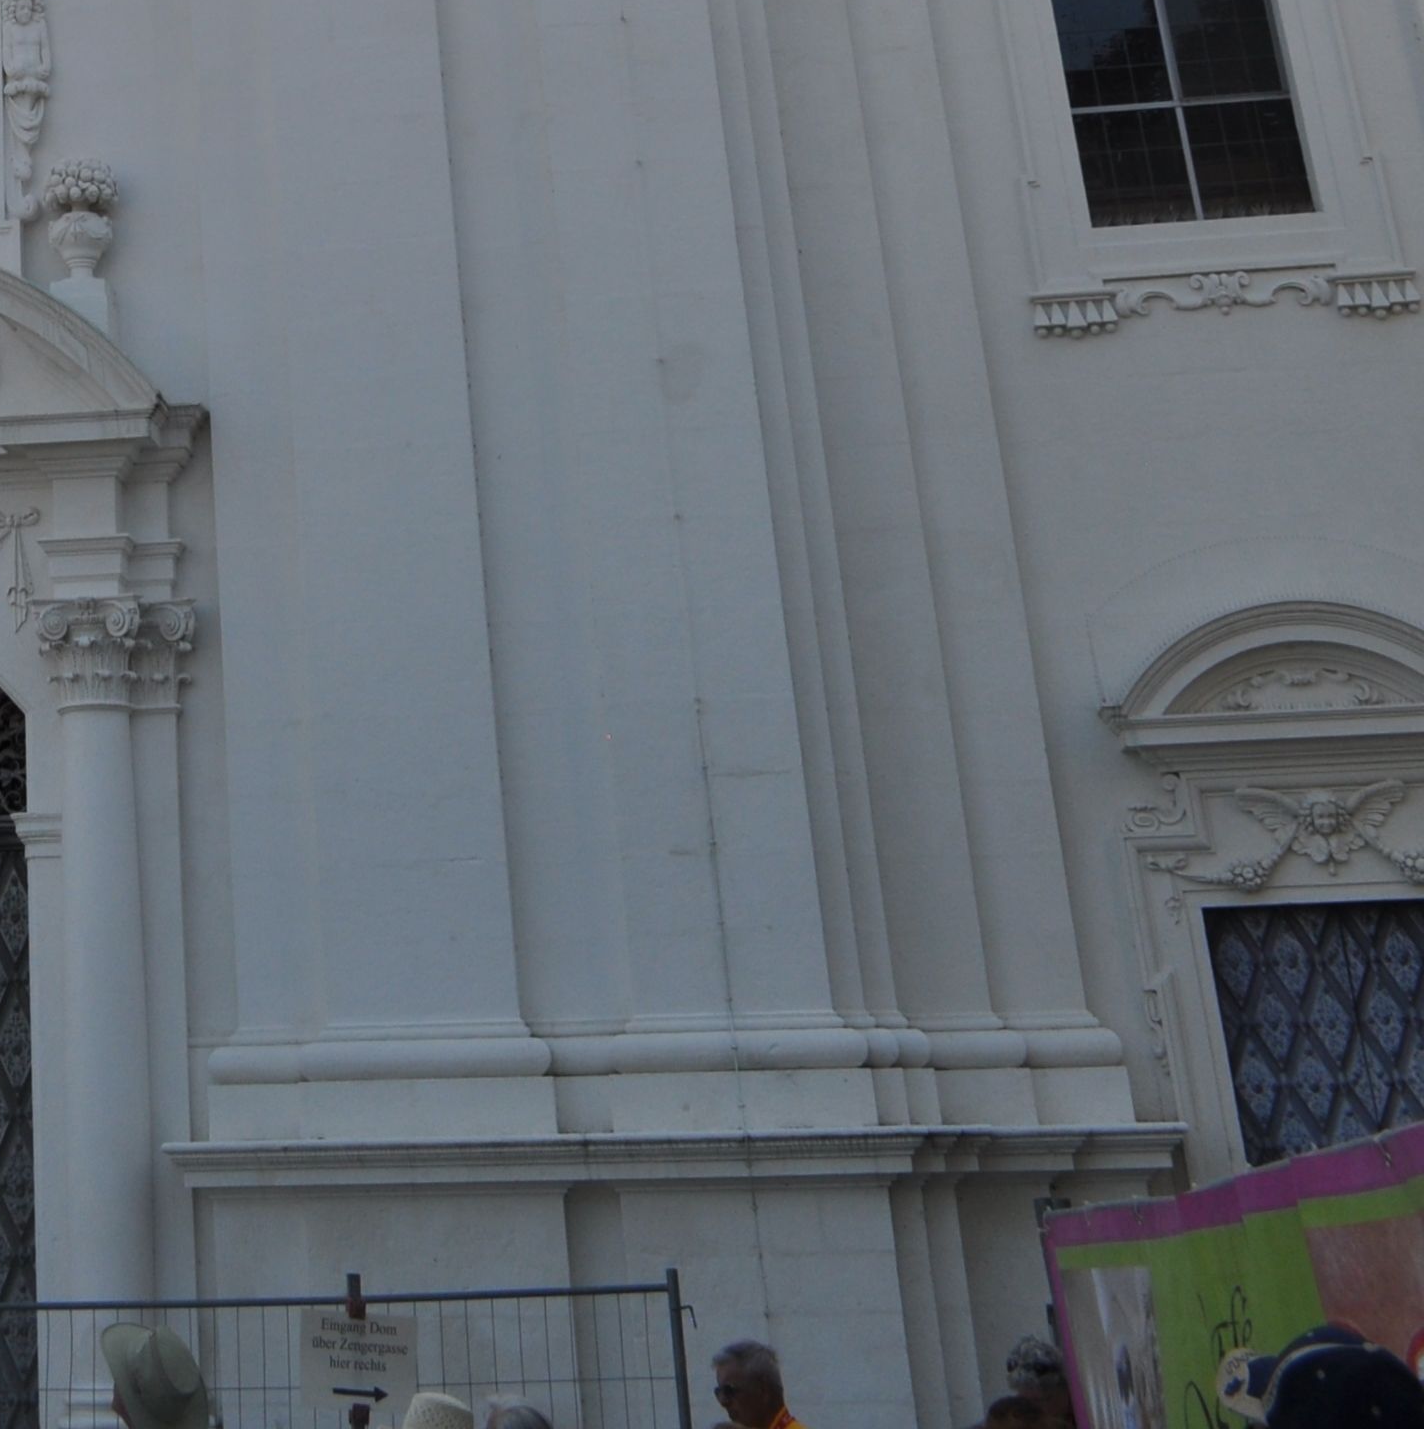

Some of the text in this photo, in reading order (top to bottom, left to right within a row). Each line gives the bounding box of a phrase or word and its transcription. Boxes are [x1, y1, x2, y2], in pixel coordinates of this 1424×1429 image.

[320, 1316, 398, 1337] Eingang Dom
[312, 1335, 409, 1356] über Zengergasse
[329, 1355, 387, 1372] hier rechts
